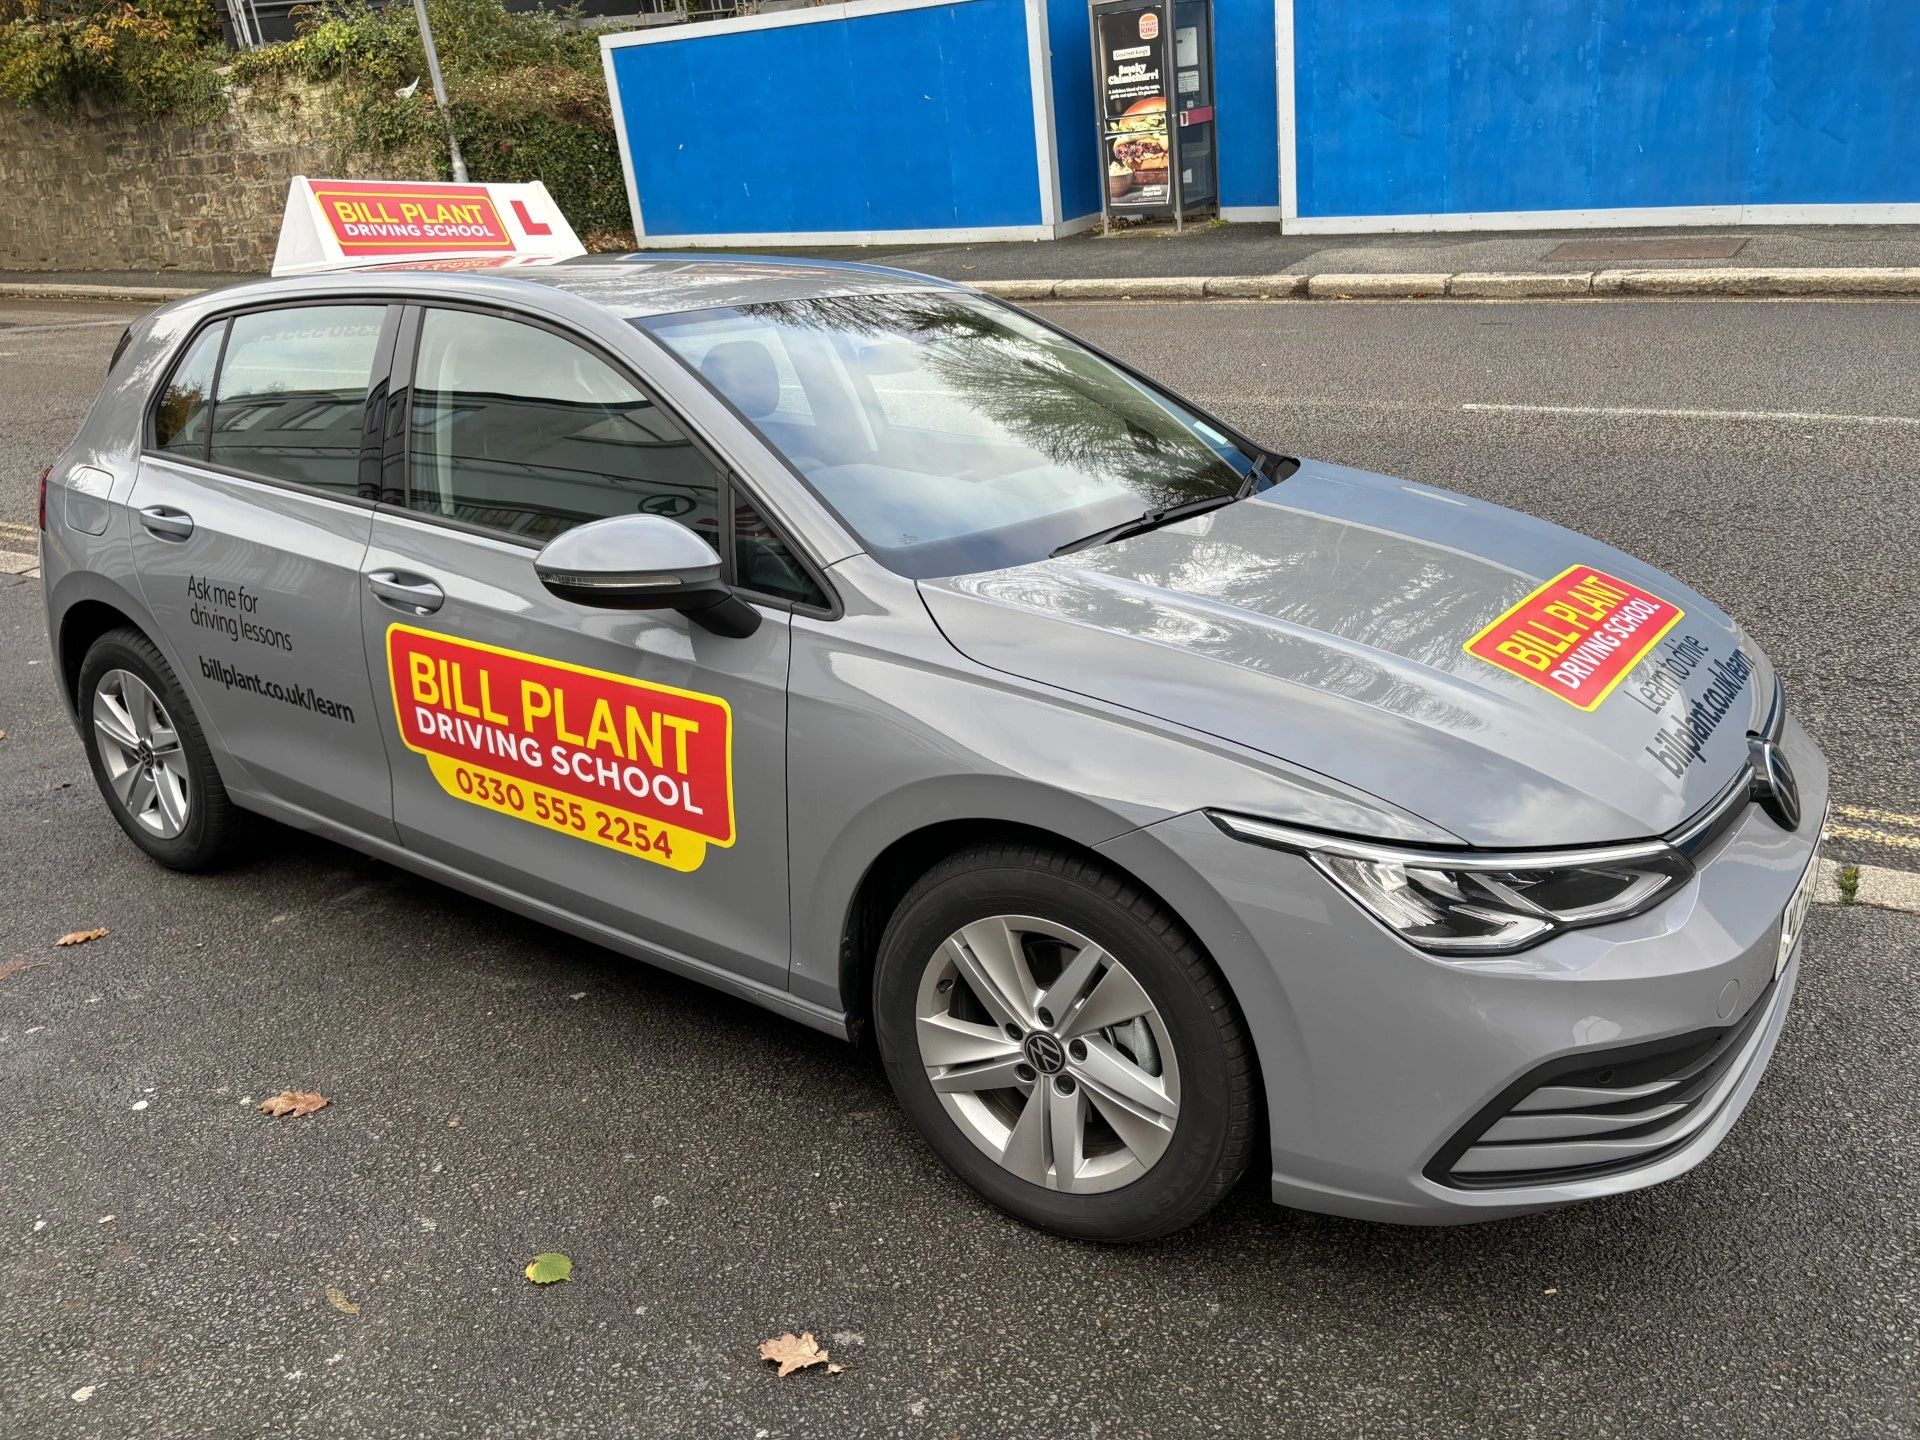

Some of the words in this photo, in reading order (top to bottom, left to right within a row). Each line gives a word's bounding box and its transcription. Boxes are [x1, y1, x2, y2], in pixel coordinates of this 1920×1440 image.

[333, 201, 400, 223] BILL
[400, 203, 484, 225] PLANT
[344, 224, 421, 237] DRIVING
[424, 225, 495, 238] SCHOOL
[510, 200, 552, 236] L
[188, 575, 212, 602] Ask
[214, 586, 236, 608] me
[239, 586, 258, 614] for
[190, 602, 238, 642] driving
[240, 614, 293, 651] lessons
[1495, 620, 1581, 672] BILL
[1543, 575, 1630, 630] PLANT
[1550, 630, 1621, 690] DRIVING
[1602, 597, 1661, 639] SCHOOL
[1655, 658, 1690, 680] to
[1664, 635, 1709, 668] drive
[199, 655, 355, 723] billplant.co.uk/learn
[1623, 669, 1682, 715] Learn
[409, 651, 508, 726] BILL
[521, 679, 699, 775] PLANT
[415, 706, 543, 768] DRIVING
[551, 745, 703, 815] SCHOOL
[455, 767, 524, 811] 0330
[535, 793, 586, 831] 555
[595, 811, 673, 859] 2254
